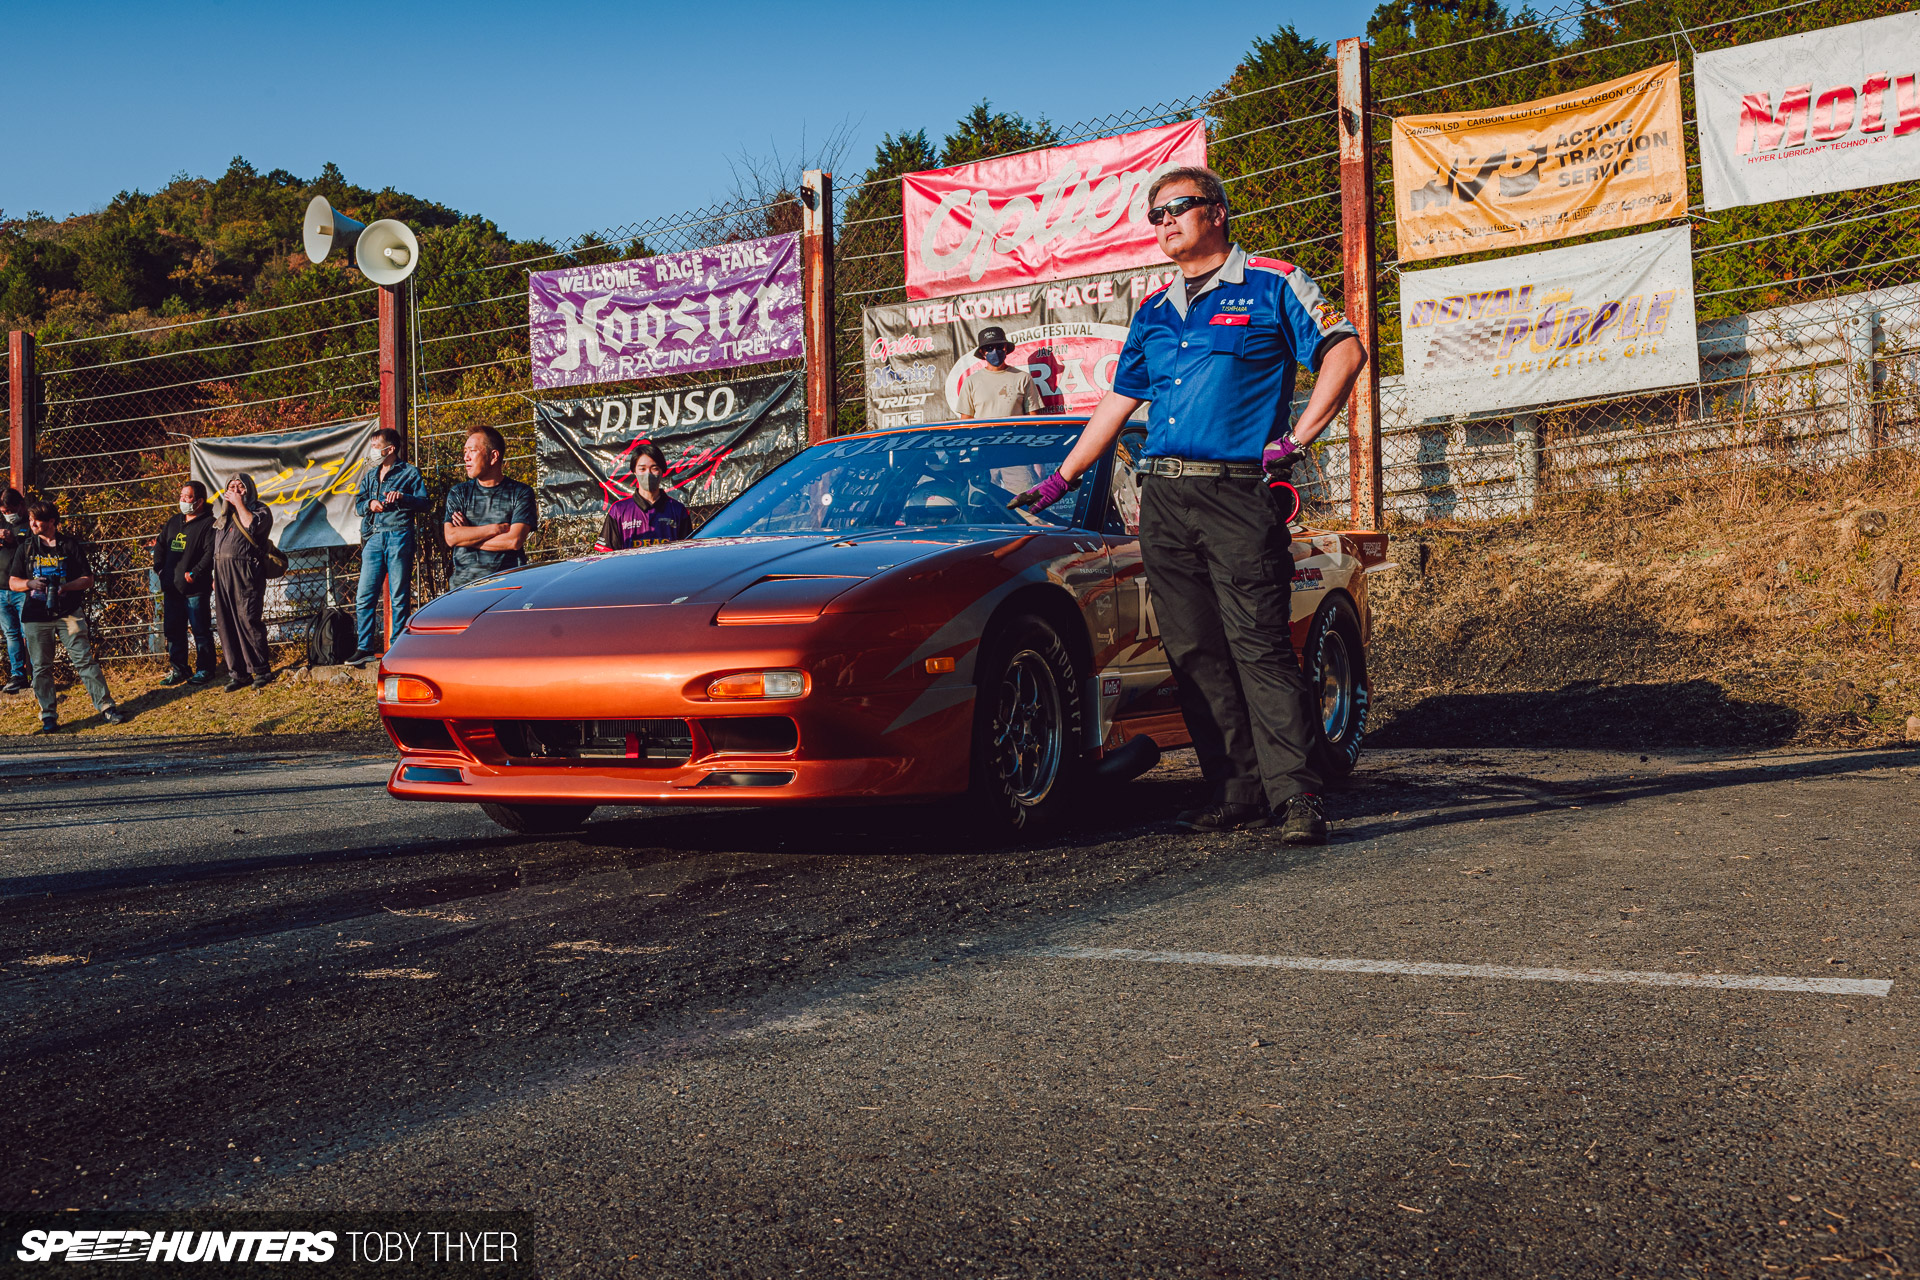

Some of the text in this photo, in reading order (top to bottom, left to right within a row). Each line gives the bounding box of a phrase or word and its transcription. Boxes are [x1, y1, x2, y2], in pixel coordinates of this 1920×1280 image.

[1405, 78, 1664, 136] CARBON LSD CARBON CLUTCH FULL CARBON CLUTCH
[1555, 118, 1633, 149] ACTIVE
[1555, 131, 1668, 168] TRACTION
[1747, 135, 1889, 164] HYPER LUBRICANT TECHNOLOGY
[1558, 156, 1651, 187] SERVICE
[921, 159, 1181, 283] Option
[557, 246, 767, 294] WELCOME RACE FANS
[908, 270, 1176, 328] WELCOME RACE FA
[1406, 284, 1534, 328] ROYAL
[549, 272, 785, 372] Hoosier
[1010, 328, 1042, 344] DRAG
[1043, 324, 1093, 338] FESTIVAL
[1496, 289, 1678, 360] PURPLE
[618, 345, 711, 375] RACING
[870, 333, 934, 363] Option
[1036, 344, 1069, 358] JAPAN
[1491, 341, 1660, 377] SYNTHETIC OIL
[871, 360, 936, 389] Hoosier
[600, 387, 735, 434] DENSO
[873, 392, 935, 410] TRUST
[884, 412, 921, 428] HKS
[813, 431, 1066, 461] KJM Racing
